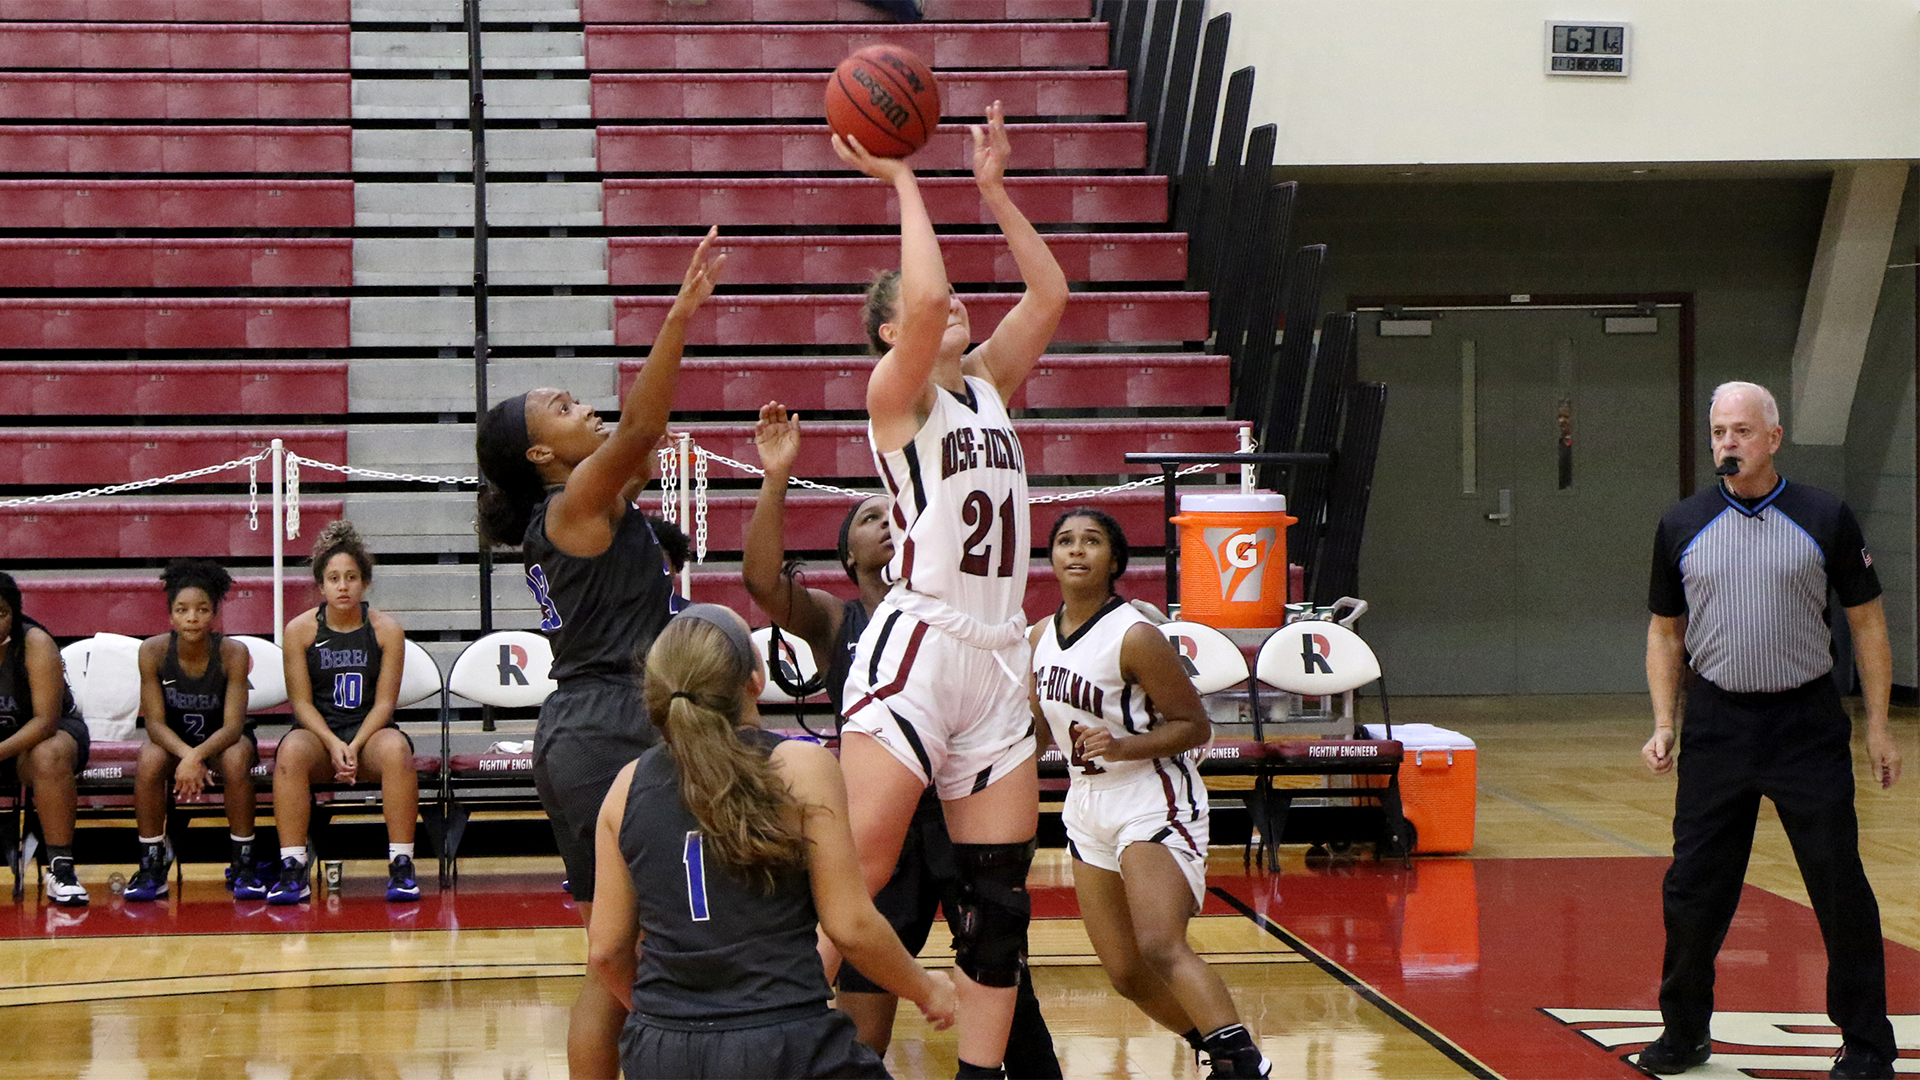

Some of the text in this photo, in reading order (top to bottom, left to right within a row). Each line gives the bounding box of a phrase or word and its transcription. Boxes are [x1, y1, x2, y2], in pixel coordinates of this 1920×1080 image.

[852, 67, 910, 130] Wilson
[959, 488, 1017, 578] 21
[1226, 533, 1258, 569] G
[165, 687, 221, 710] BEREA
[333, 672, 363, 709] 10
[183, 713, 206, 742] 2
[479, 758, 533, 771] FIGHTIN' ENGIN
[1068, 720, 1107, 775] 4
[1309, 745, 1379, 758] FIGHTIN' ENGINEERS
[83, 767, 122, 779] ENGINEERS
[682, 830, 710, 921] 1
